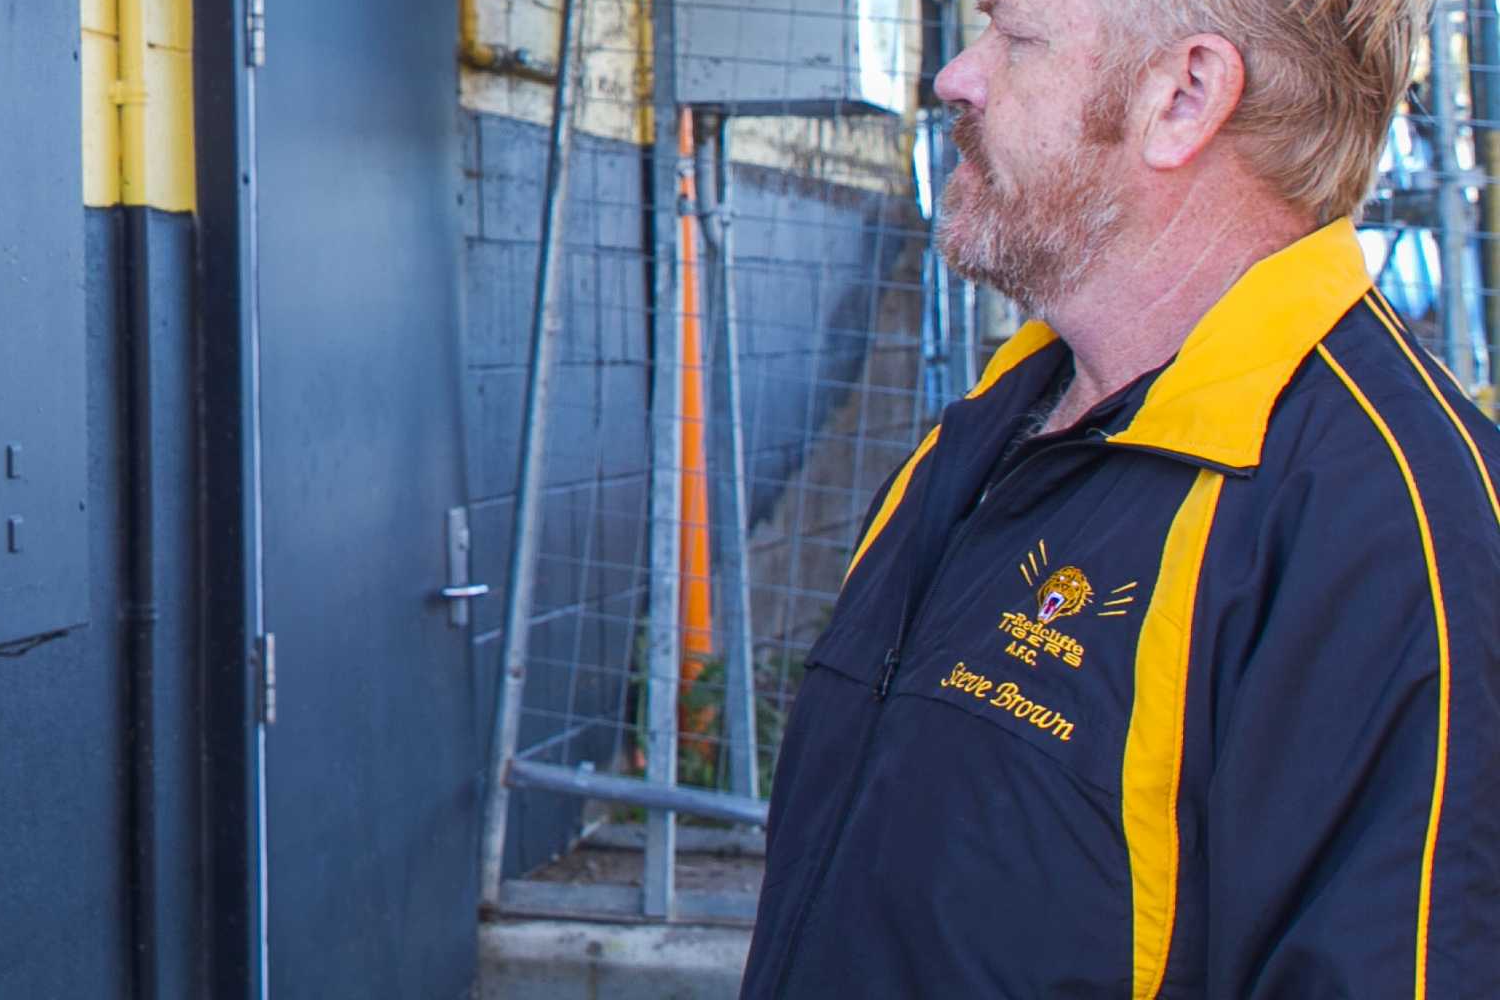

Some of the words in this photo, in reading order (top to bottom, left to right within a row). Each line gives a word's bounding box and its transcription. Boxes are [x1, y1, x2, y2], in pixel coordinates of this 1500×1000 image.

[1011, 612, 1085, 656] Redcliffe
[940, 661, 993, 698] Steve
[989, 682, 1075, 741] Brown
